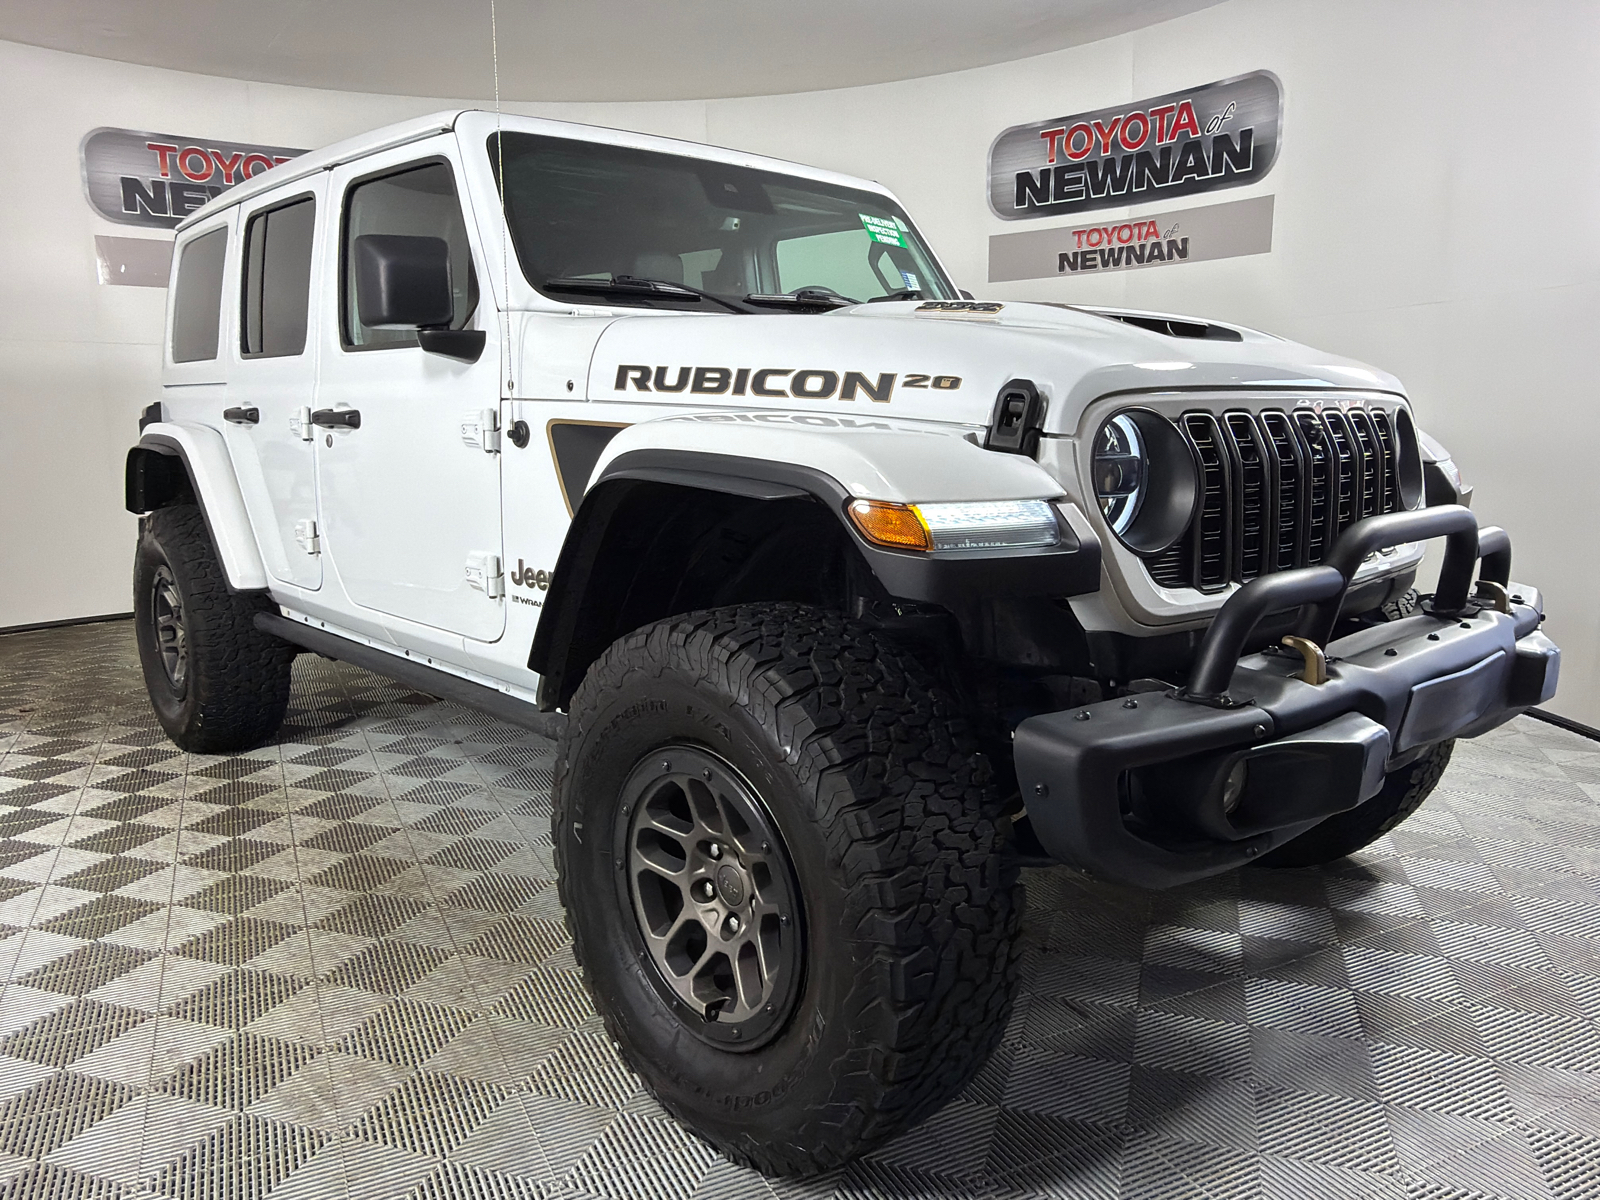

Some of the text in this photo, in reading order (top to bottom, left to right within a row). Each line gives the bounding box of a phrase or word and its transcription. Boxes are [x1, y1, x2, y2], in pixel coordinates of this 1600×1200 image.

[1040, 99, 1236, 165] TOYOTA of
[146, 141, 294, 185] TOYO
[1013, 126, 1255, 209] NEWNAN
[120, 176, 227, 217] NE
[1071, 219, 1160, 249] TOYOTA
[1057, 236, 1190, 274] NEWNAN
[613, 364, 963, 403] RUBICON 20
